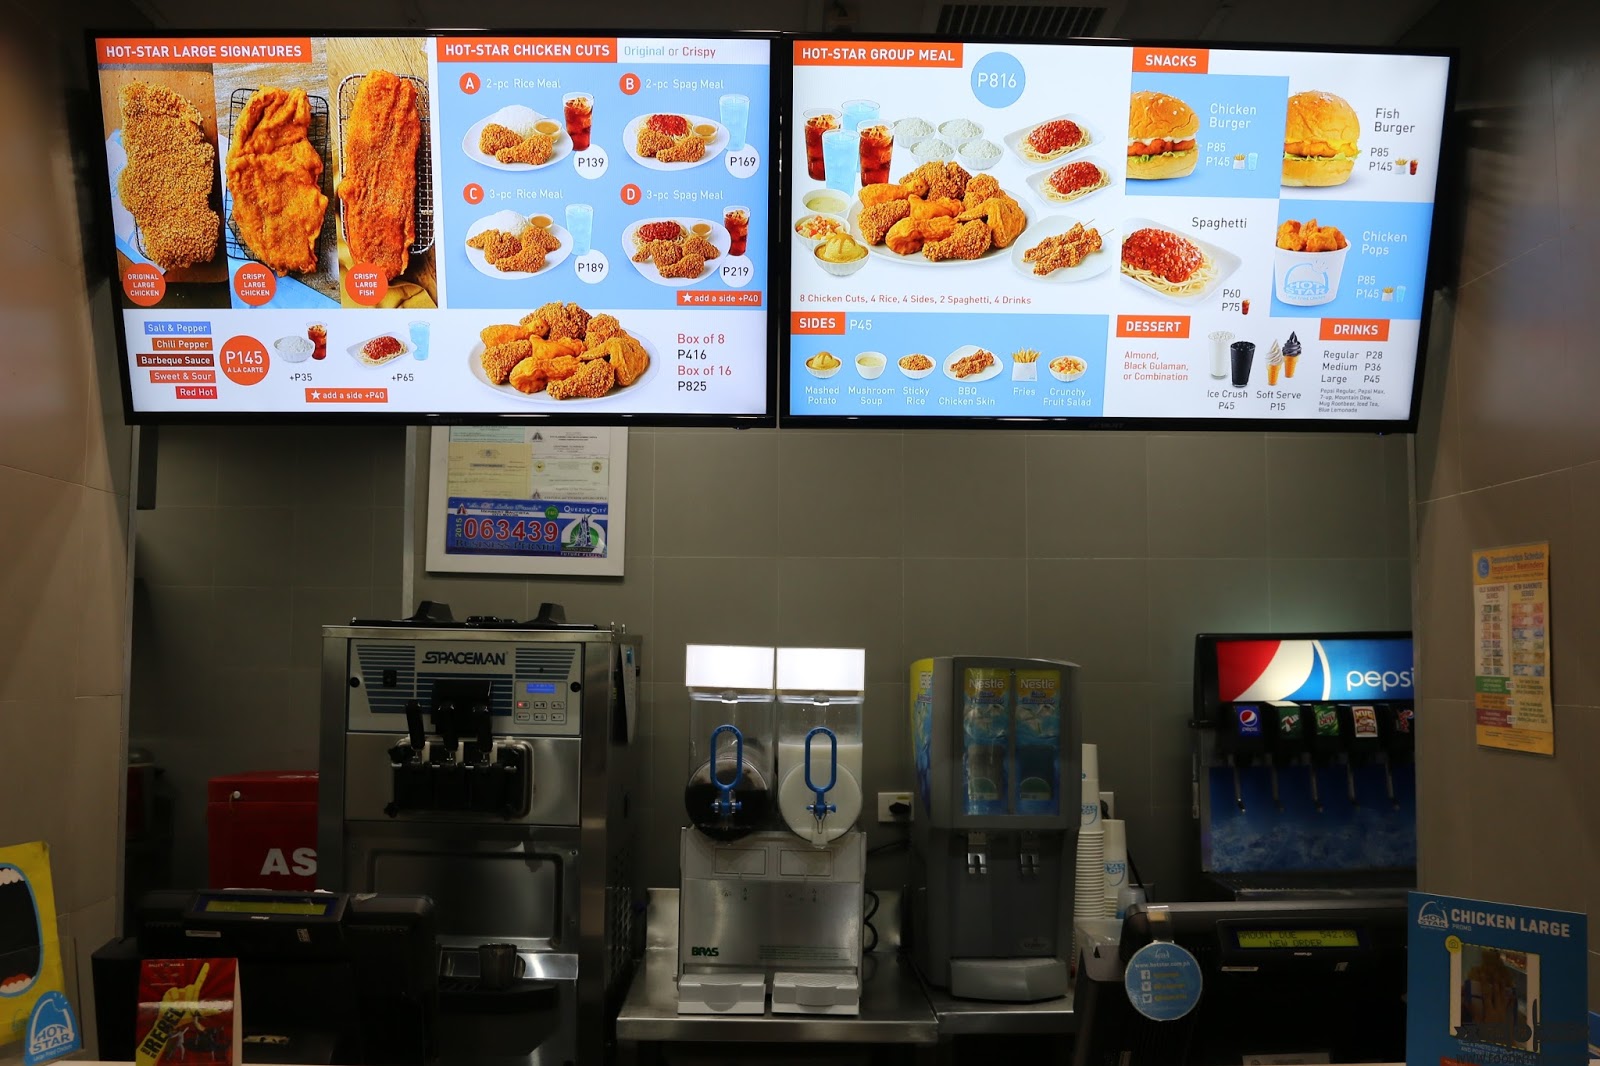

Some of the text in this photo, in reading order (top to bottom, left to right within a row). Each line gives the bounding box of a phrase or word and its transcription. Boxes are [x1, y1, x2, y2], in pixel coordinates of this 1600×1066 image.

[106, 45, 302, 58] HOT-STAR LARGE SIGNATURES
[445, 44, 610, 57] HOT-STAR CHICKEN CUTS
[624, 45, 716, 59] Original or Crispy
[802, 47, 955, 61] HOT-STAR GROUP MEAL
[1145, 55, 1197, 67] SNACKS
[486, 78, 561, 91] 2-pc Rice Meal
[645, 78, 724, 91] 2-pc Spag Meal
[977, 73, 1017, 88] P816
[1210, 103, 1257, 115] Chicken
[1376, 108, 1400, 119] Fish
[1209, 117, 1251, 130] Burger
[1374, 122, 1415, 135] Burger
[1207, 142, 1226, 152] P85
[1370, 148, 1389, 158] P85
[577, 157, 604, 168] P139
[730, 156, 756, 167] P169
[1205, 156, 1230, 167] P145
[1368, 161, 1392, 172] P145
[489, 188, 563, 201] 3-pc Rice Meal
[646, 189, 723, 202] 3-pc Spag Meal
[1192, 217, 1247, 230] Spaghetti
[1362, 231, 1407, 243] Chicken
[1361, 244, 1389, 257] Pops
[577, 262, 604, 273] P189
[723, 266, 749, 277] P219
[242, 273, 266, 281] CRISPY
[353, 273, 378, 281] CRISPY
[132, 281, 155, 289] LARGE
[130, 289, 159, 297] CHICKEN
[241, 289, 270, 297] CHICKEN
[359, 289, 375, 297] FISH
[694, 293, 709, 302] add
[719, 293, 736, 302] side
[738, 293, 758, 302] +P40
[1222, 289, 1241, 298] P60
[799, 294, 1032, 307] 8 Chicken Cuts, 4 Rice, 4 Sides, 2 Spaghetti, 4 Drinks
[1221, 302, 1240, 312] P75
[148, 324, 207, 334] Salt & Pepper
[799, 318, 836, 329] SIDES
[849, 320, 872, 331] P45
[1125, 321, 1182, 332] DESSERT
[1333, 324, 1379, 335] DRINKS
[677, 334, 725, 344] Box of 8
[156, 340, 209, 351] Chili Pepper
[226, 350, 263, 365] P145
[677, 350, 707, 360] P416
[1124, 351, 1159, 360] Almond,
[1323, 350, 1383, 361] Regular P28
[141, 356, 210, 367] Barbeque Sauce
[1124, 362, 1189, 372] Black Gulaman,
[677, 365, 732, 376] Box of 16
[1322, 363, 1382, 372] Medium P36
[154, 372, 212, 381] Sweet & Sour
[289, 373, 313, 382] +P35
[391, 373, 414, 382] +P65
[1123, 372, 1189, 381] or Combination
[1321, 375, 1380, 385] Large P45
[180, 388, 213, 396] Red Hot
[677, 381, 707, 392] P825
[805, 386, 840, 394] Mashed
[848, 386, 896, 395] Mushroom
[902, 386, 930, 397] Sticky
[958, 387, 977, 396] BBQ
[1013, 387, 1036, 396] Fries
[1049, 387, 1086, 398] Crunchy
[1207, 390, 1248, 399] Ice Crush
[1256, 390, 1302, 399] Soft Serve
[807, 396, 837, 405] Potato
[860, 396, 883, 407] Soup
[906, 397, 926, 405] Rice
[938, 397, 995, 406] Chicken Skin
[1043, 397, 1091, 406] Fruit Salad
[1218, 401, 1235, 410] P45
[1270, 402, 1286, 411] P15
[455, 517, 463, 538] 2015
[463, 517, 559, 543] 063439
[422, 651, 506, 665] SPACEMAN
[1346, 667, 1415, 692] pepsi
[260, 847, 317, 877] AS
[1451, 908, 1571, 938] CHICKEN LARGE
[1452, 924, 1472, 932] PROMO
[1238, 931, 1272, 939] AMOUNT
[691, 946, 719, 957] BRAS
[37, 1026, 65, 1042] HOT
[33, 1033, 70, 1053] STAR
